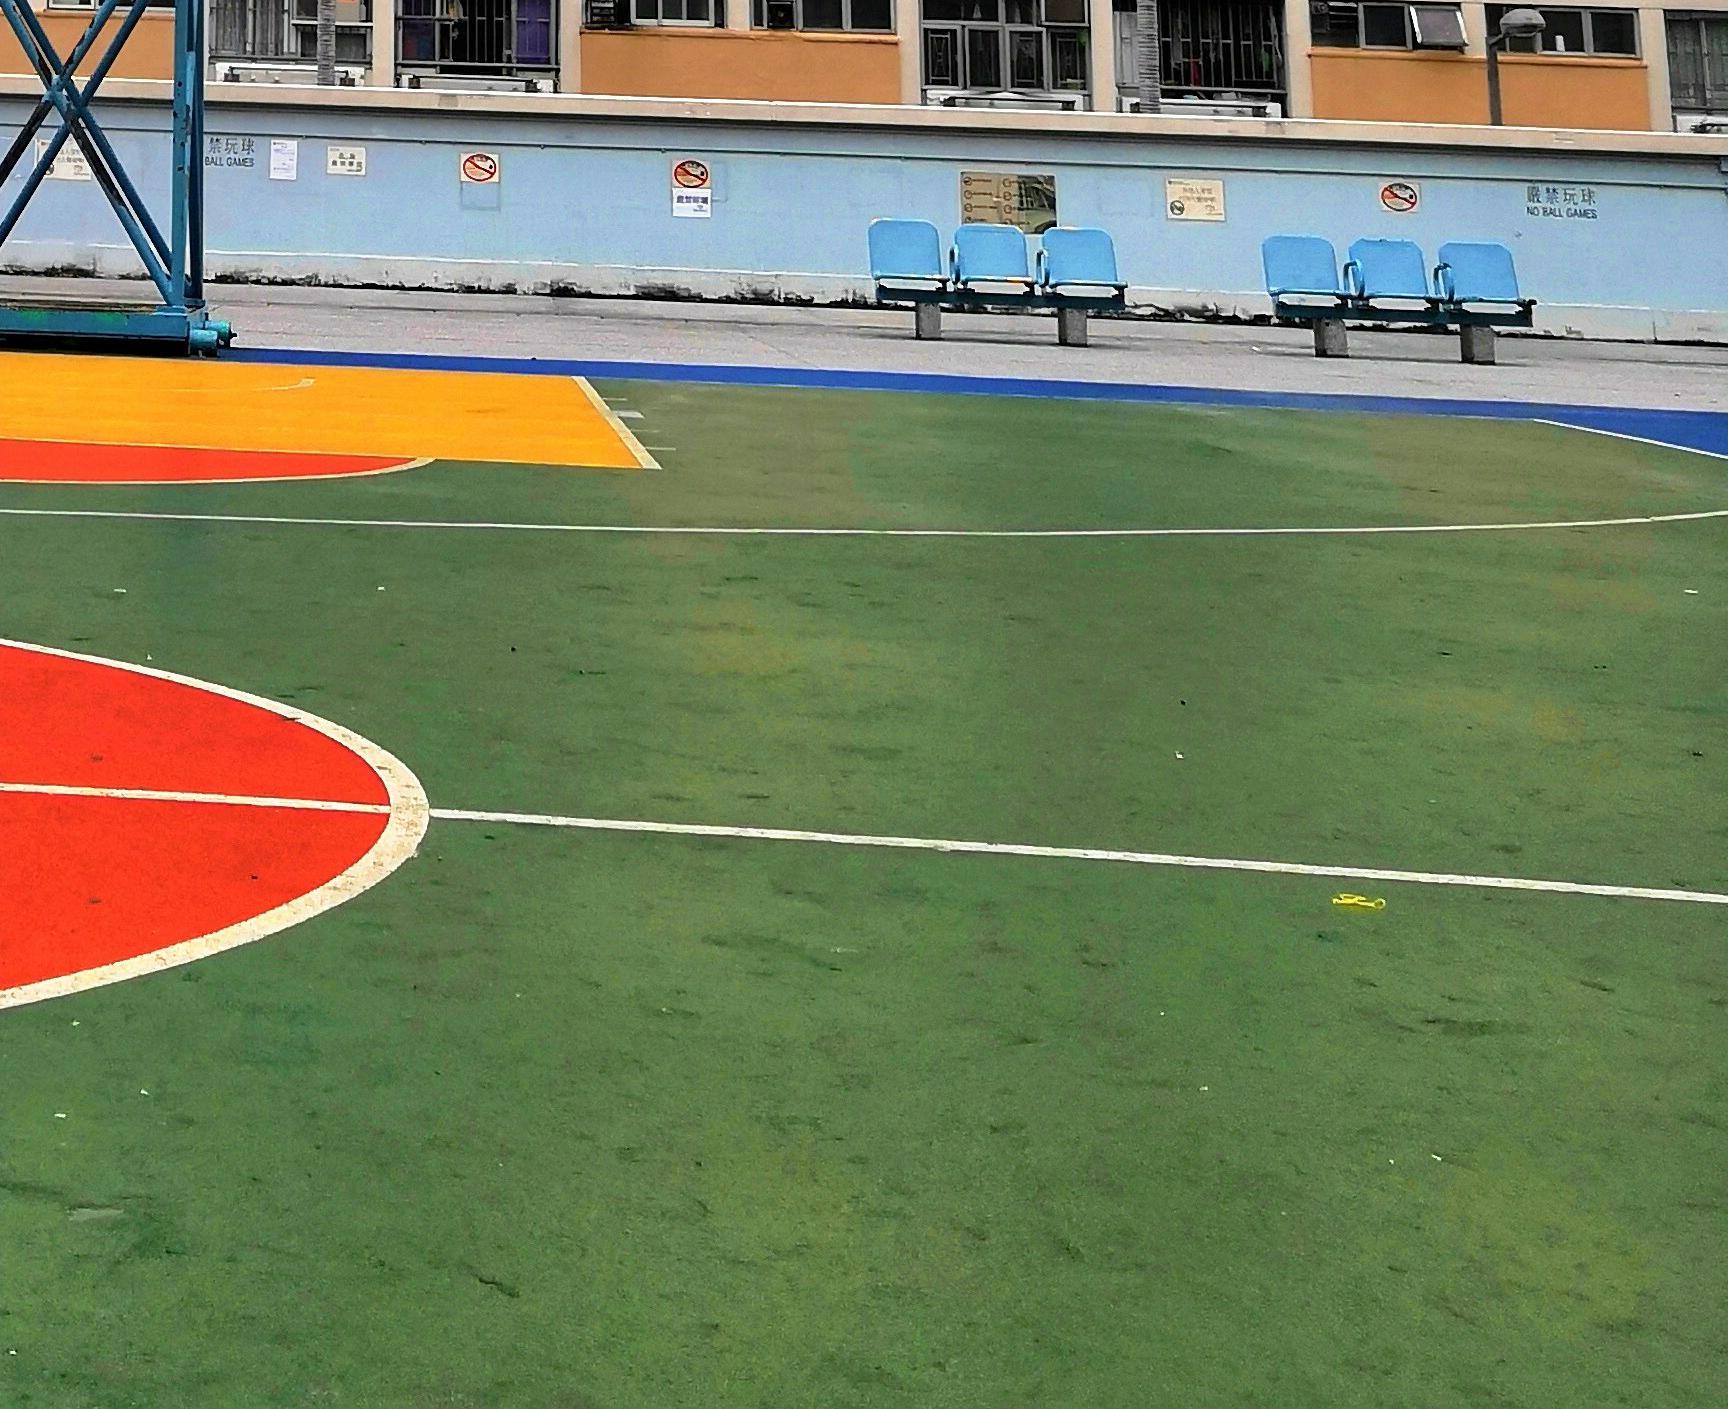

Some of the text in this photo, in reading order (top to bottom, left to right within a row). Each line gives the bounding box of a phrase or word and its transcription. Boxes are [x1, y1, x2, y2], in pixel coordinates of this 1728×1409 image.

[207, 137, 255, 155] 禁玩球
[204, 156, 255, 168] BALL GAMES
[1526, 206, 1598, 219] NO BALL GAMES
